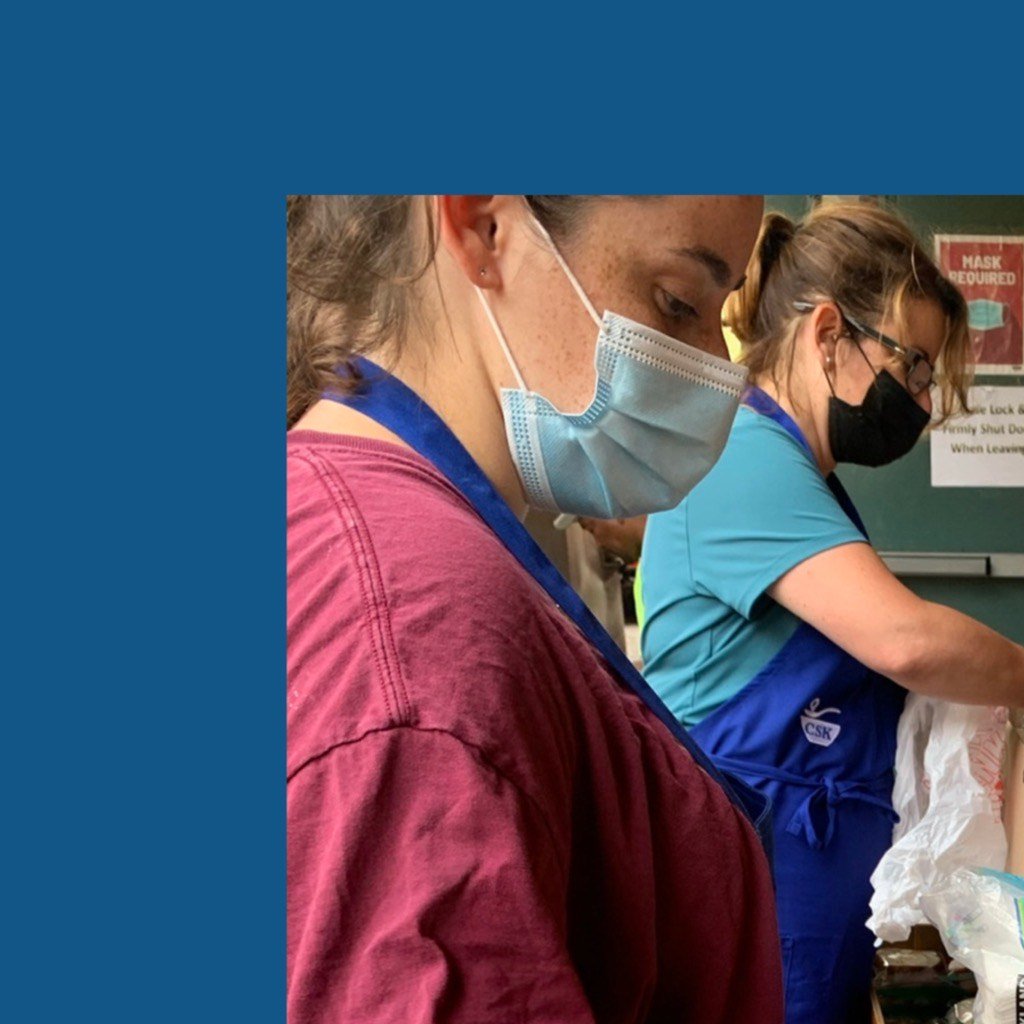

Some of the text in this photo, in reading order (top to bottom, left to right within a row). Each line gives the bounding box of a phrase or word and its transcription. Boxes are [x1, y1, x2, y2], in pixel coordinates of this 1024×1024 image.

[962, 255, 1002, 269] MASK
[949, 271, 1016, 286] REQUIRED
[989, 404, 1014, 415] Lock
[943, 424, 977, 435] Firmly
[981, 424, 1005, 434] Shut
[951, 444, 983, 454] When
[804, 721, 832, 741] CSK
